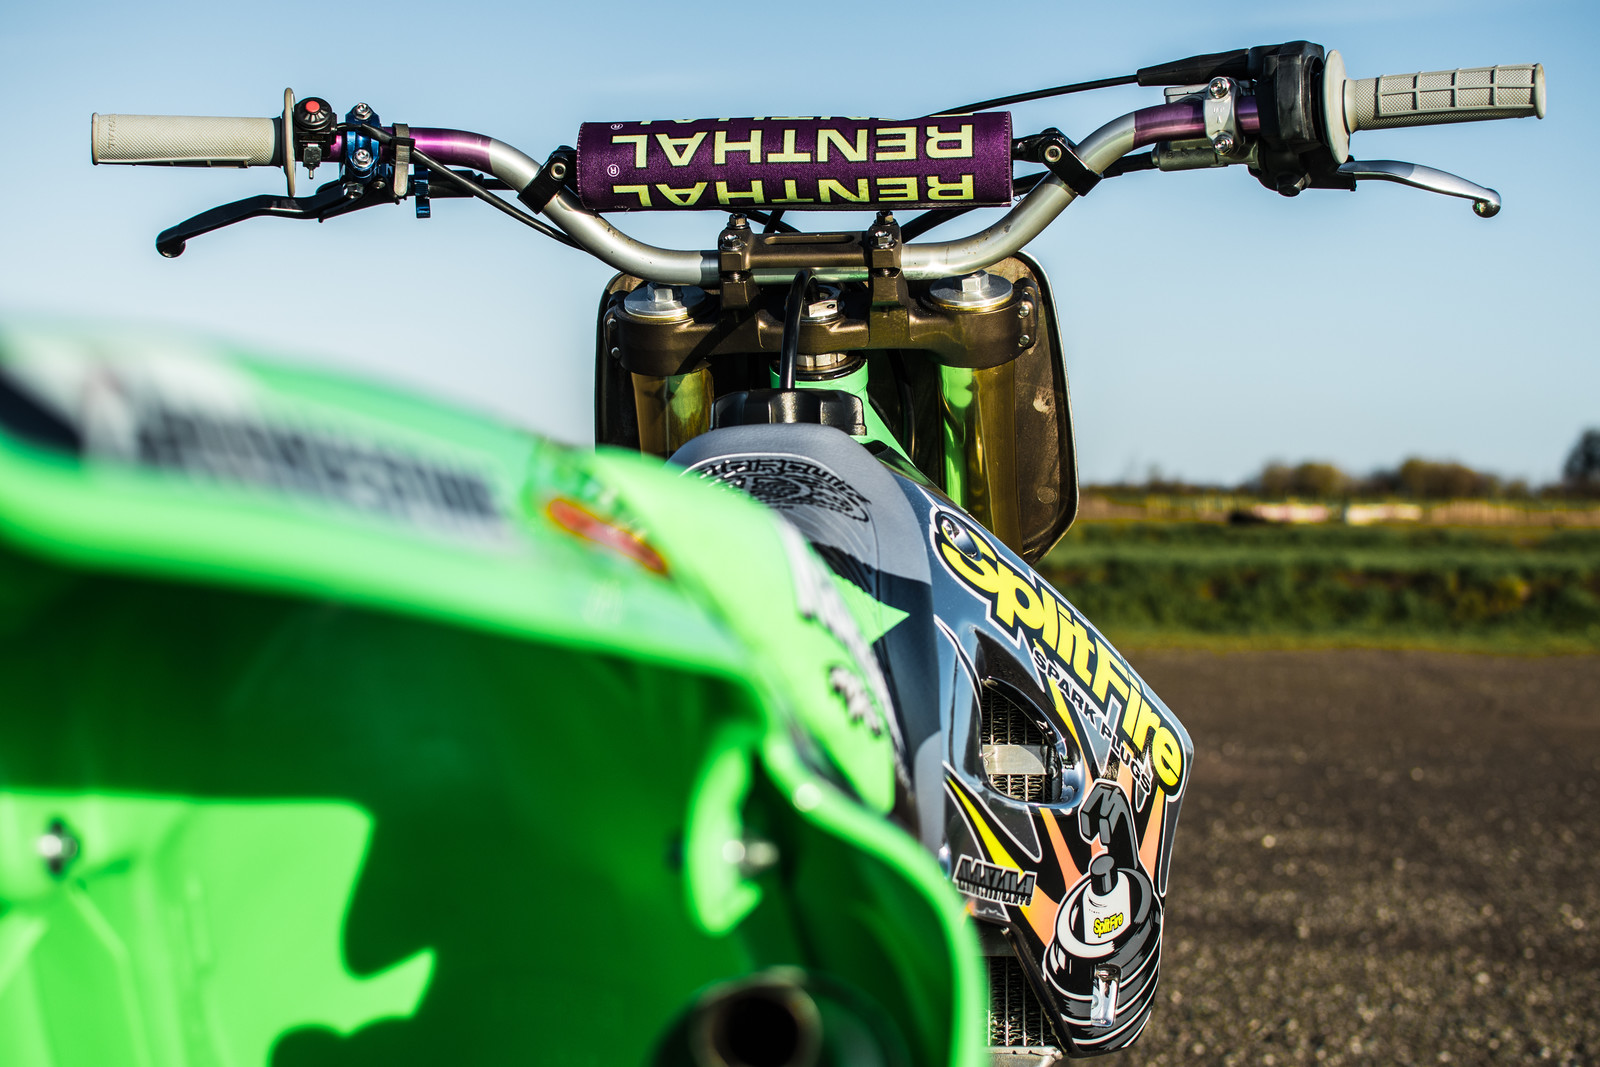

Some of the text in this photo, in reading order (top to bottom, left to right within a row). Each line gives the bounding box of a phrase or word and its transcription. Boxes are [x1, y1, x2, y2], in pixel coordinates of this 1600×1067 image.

[612, 124, 974, 168] RENTHAL
[612, 174, 975, 207] RENTHAL
[941, 514, 1182, 787] SplitFire
[1033, 648, 1150, 793] SPARK PLUGS
